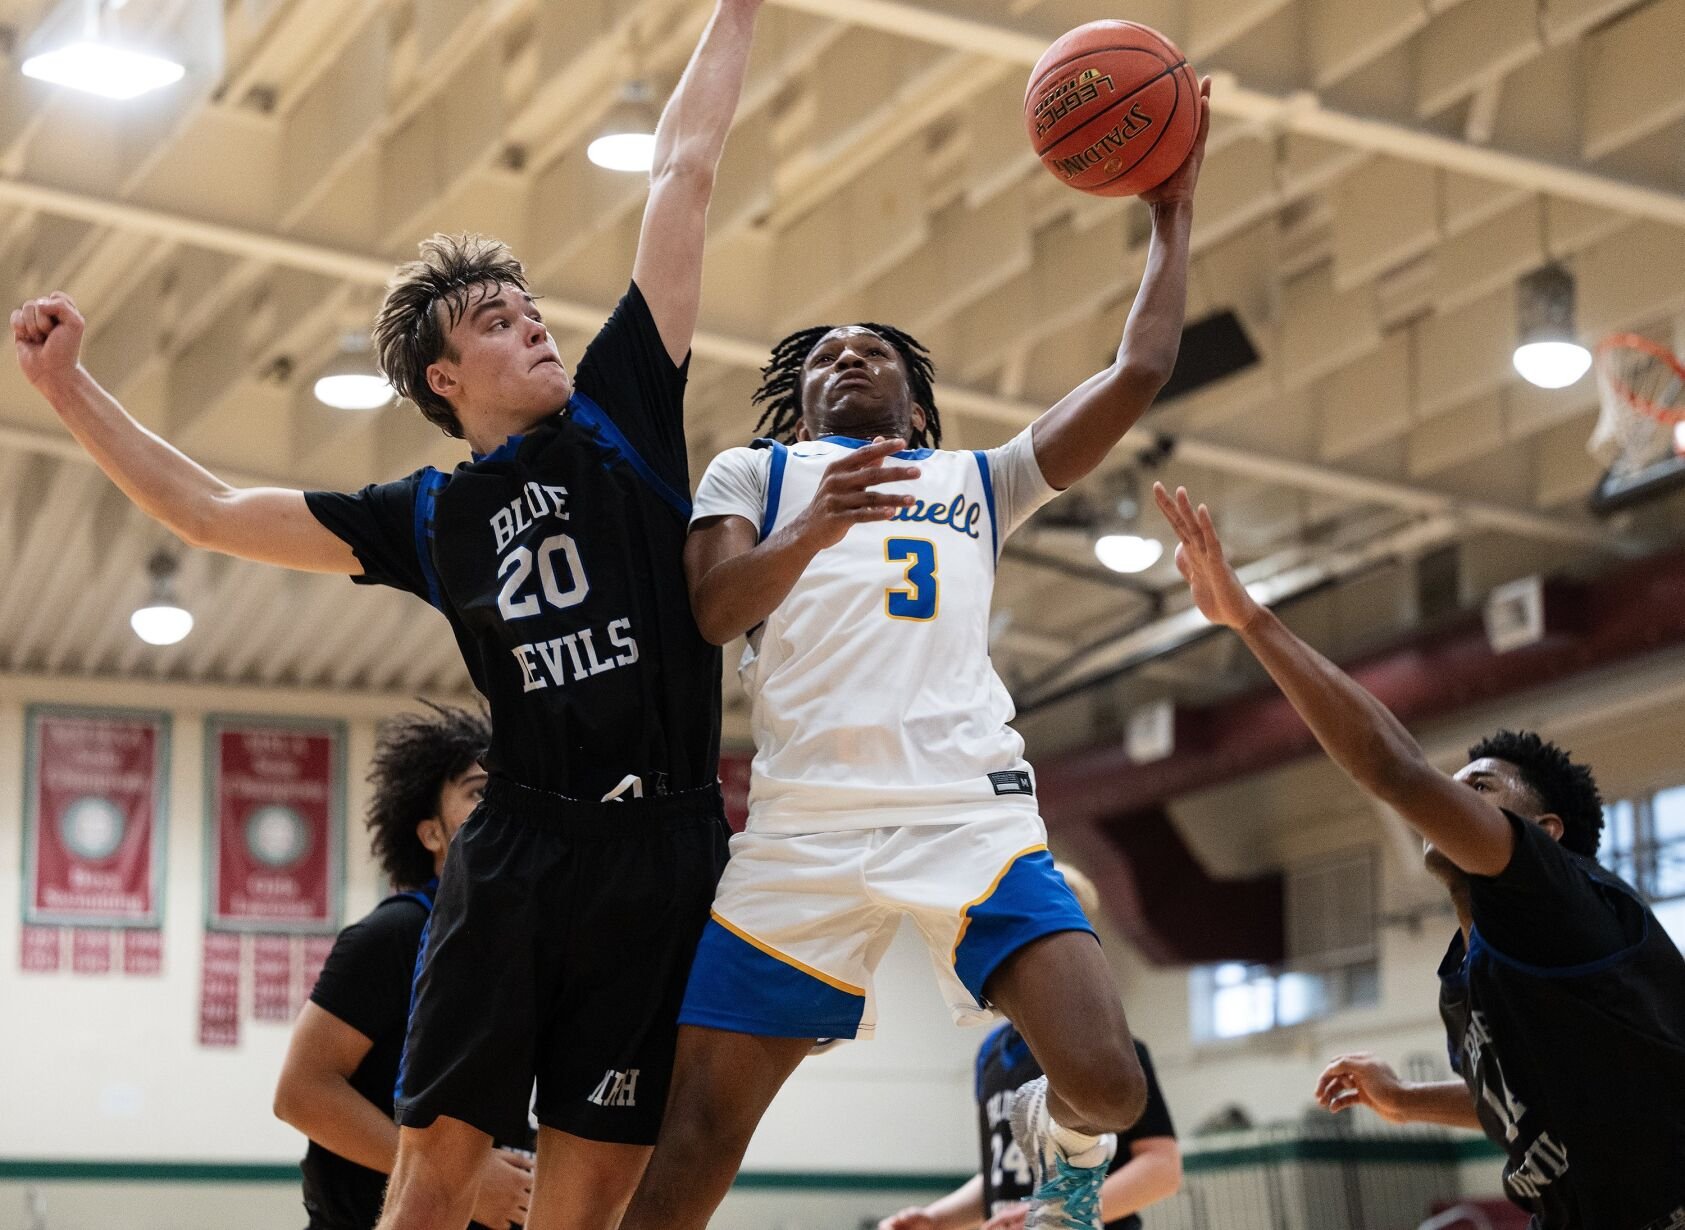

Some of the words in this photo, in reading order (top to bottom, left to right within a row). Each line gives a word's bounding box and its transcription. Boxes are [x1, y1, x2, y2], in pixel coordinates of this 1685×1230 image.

[1036, 74, 1116, 140] LEGACY
[1053, 103, 1153, 179] SPALDING
[489, 480, 570, 555] BLUE
[497, 533, 590, 622] 20
[883, 536, 940, 623] 3
[511, 617, 640, 694] EVILS
[991, 1132, 1032, 1187] 14
